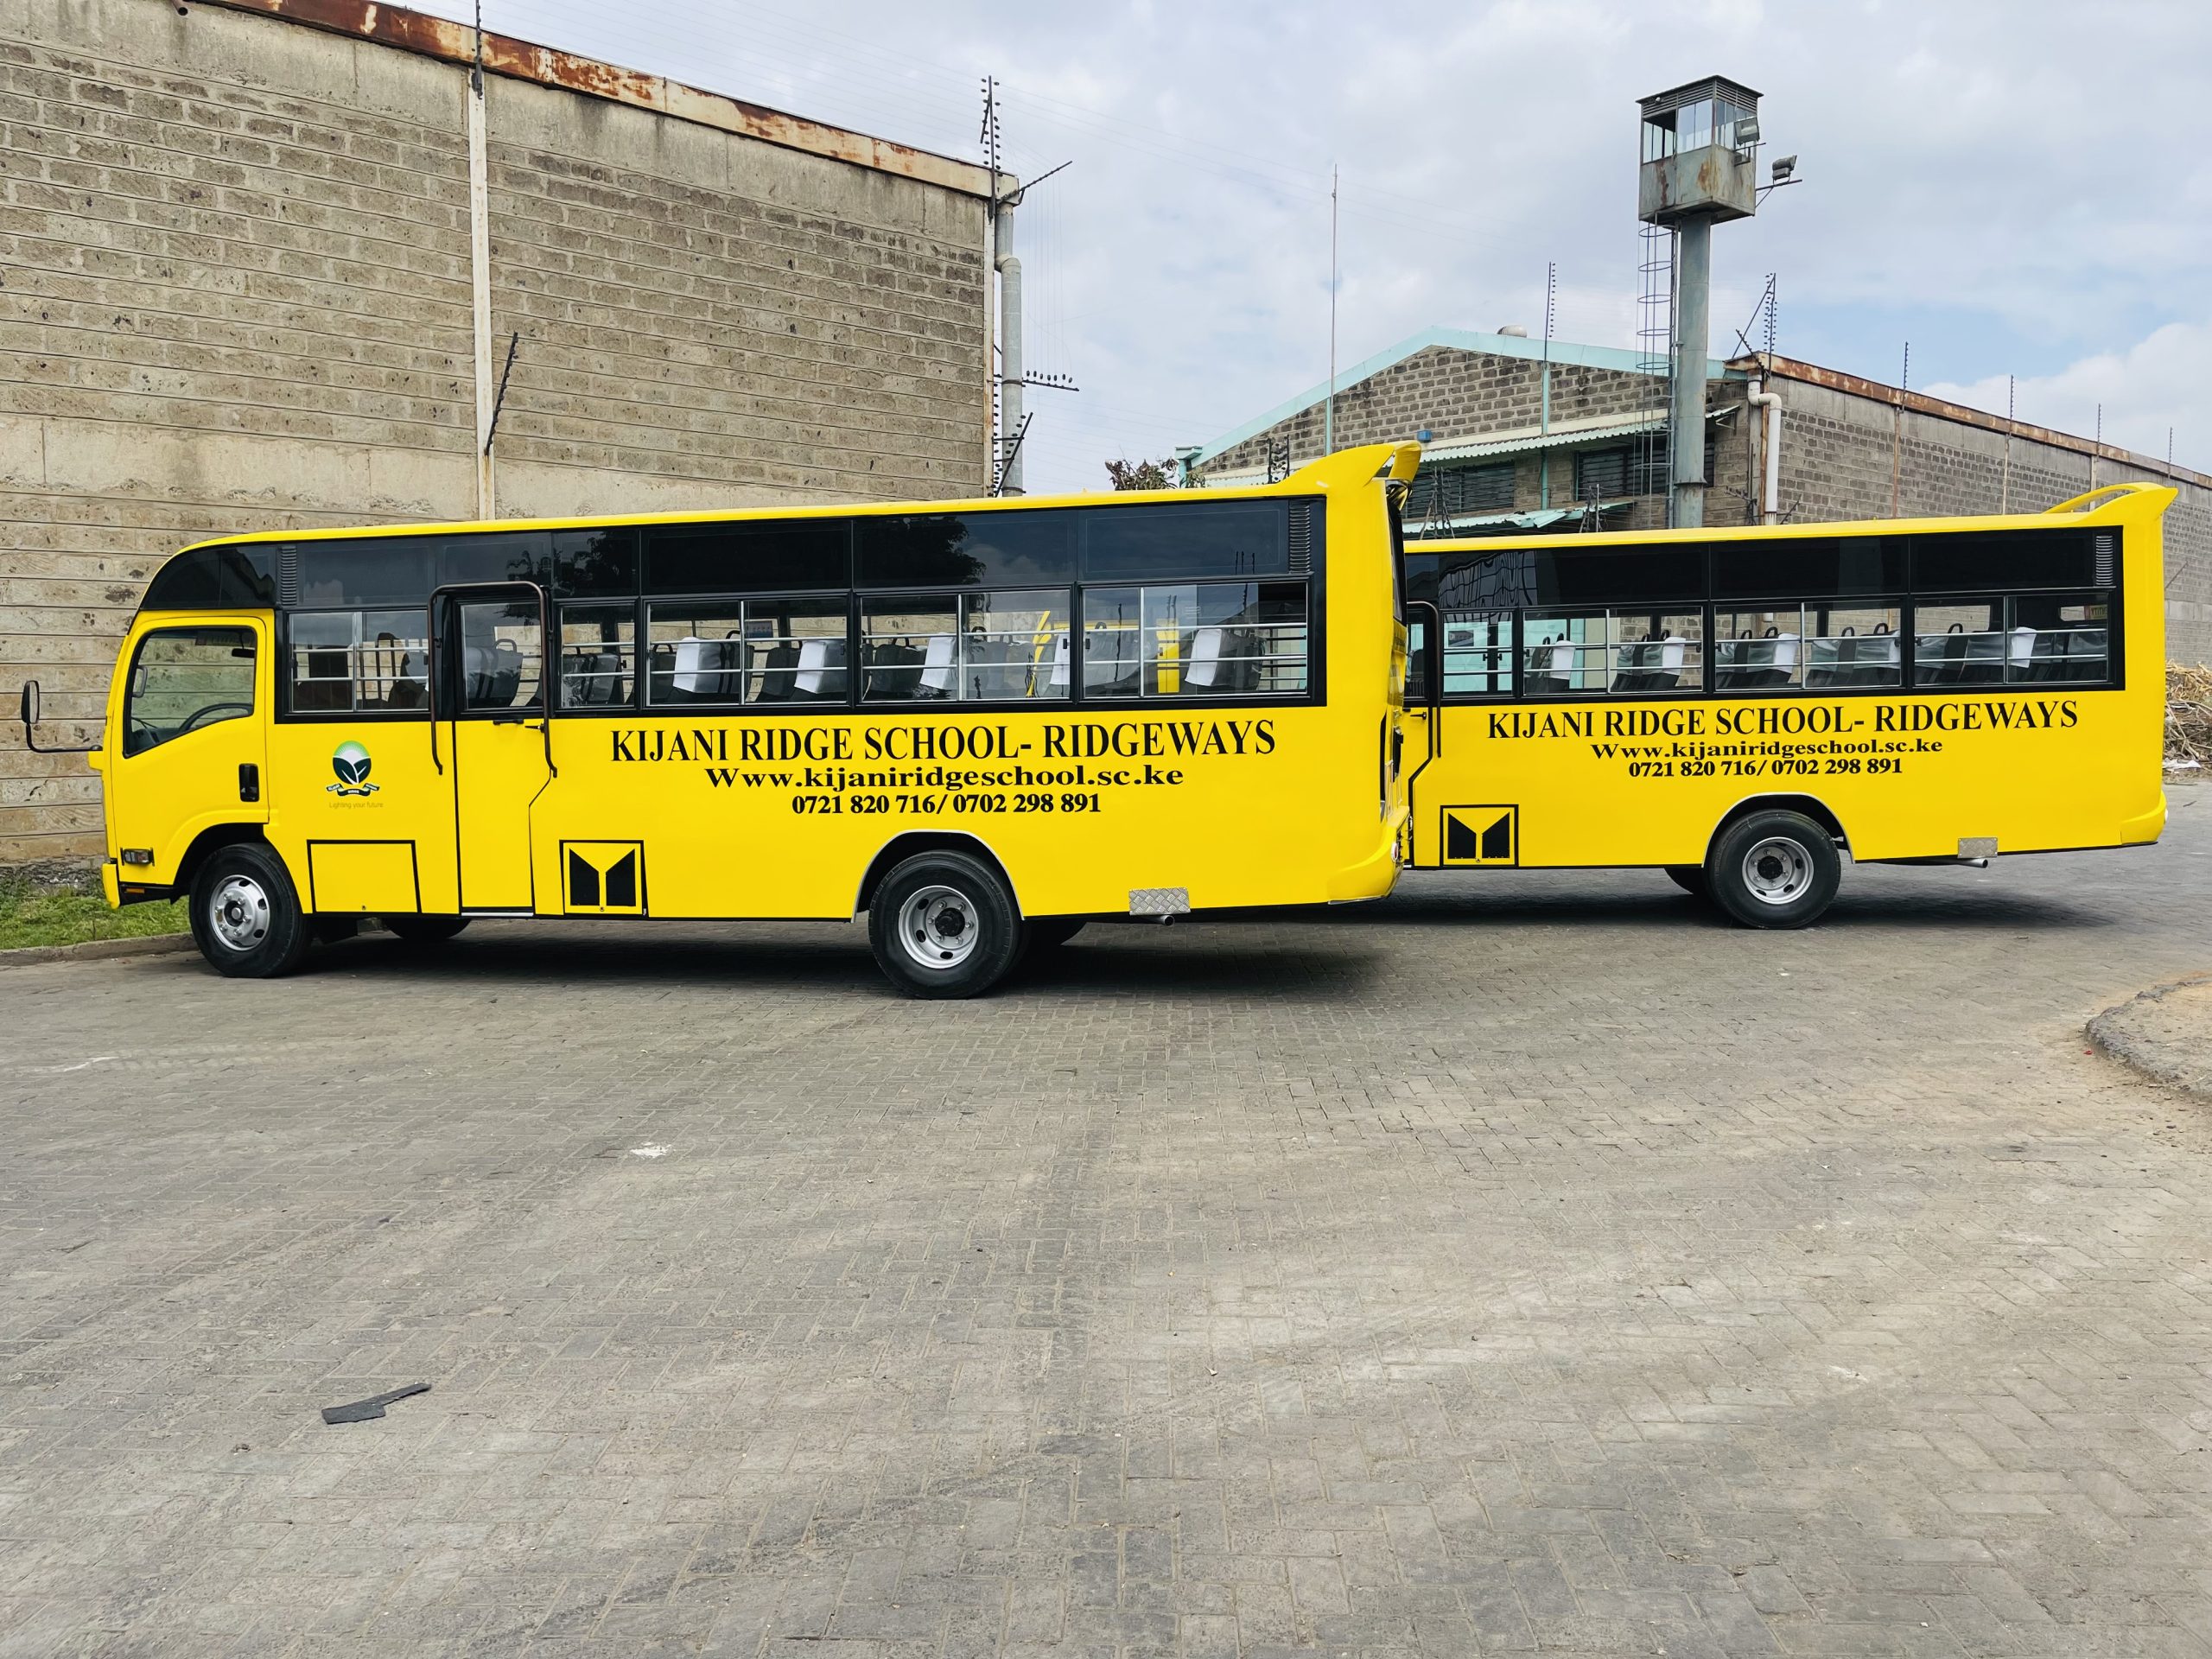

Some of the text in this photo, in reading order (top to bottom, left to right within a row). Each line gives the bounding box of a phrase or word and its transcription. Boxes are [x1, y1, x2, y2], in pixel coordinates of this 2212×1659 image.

[1488, 700, 2078, 740] KIJANI RIDGE SCHOOL- RIDGEWAYS
[612, 719, 1275, 762] KIJANI RIDGE SCHOOL- RIDGEWAYS
[1591, 738, 1942, 760] Www.kijaniridgeschool.sc.ke
[704, 765, 1184, 791] Www.kijaniridgeschool.sc.ke
[1629, 758, 1902, 778] 0721 820 716/ 0702 298 891
[791, 793, 1101, 815] 0721 820 716/ 0702 298 891
